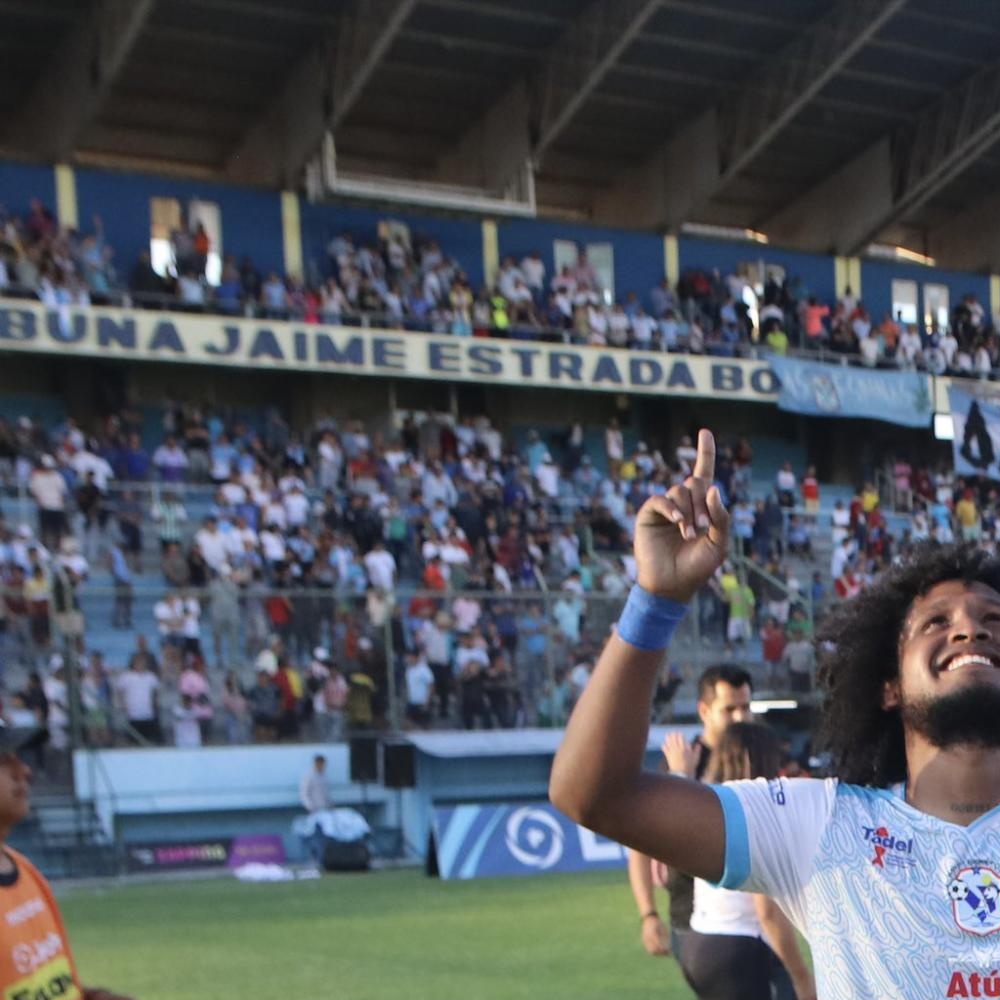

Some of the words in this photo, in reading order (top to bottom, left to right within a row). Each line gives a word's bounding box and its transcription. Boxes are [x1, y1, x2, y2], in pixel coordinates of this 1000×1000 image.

[205, 326, 406, 370] JAIME
[428, 341, 696, 388] ESTRADA
[862, 826, 914, 854] Tadel
